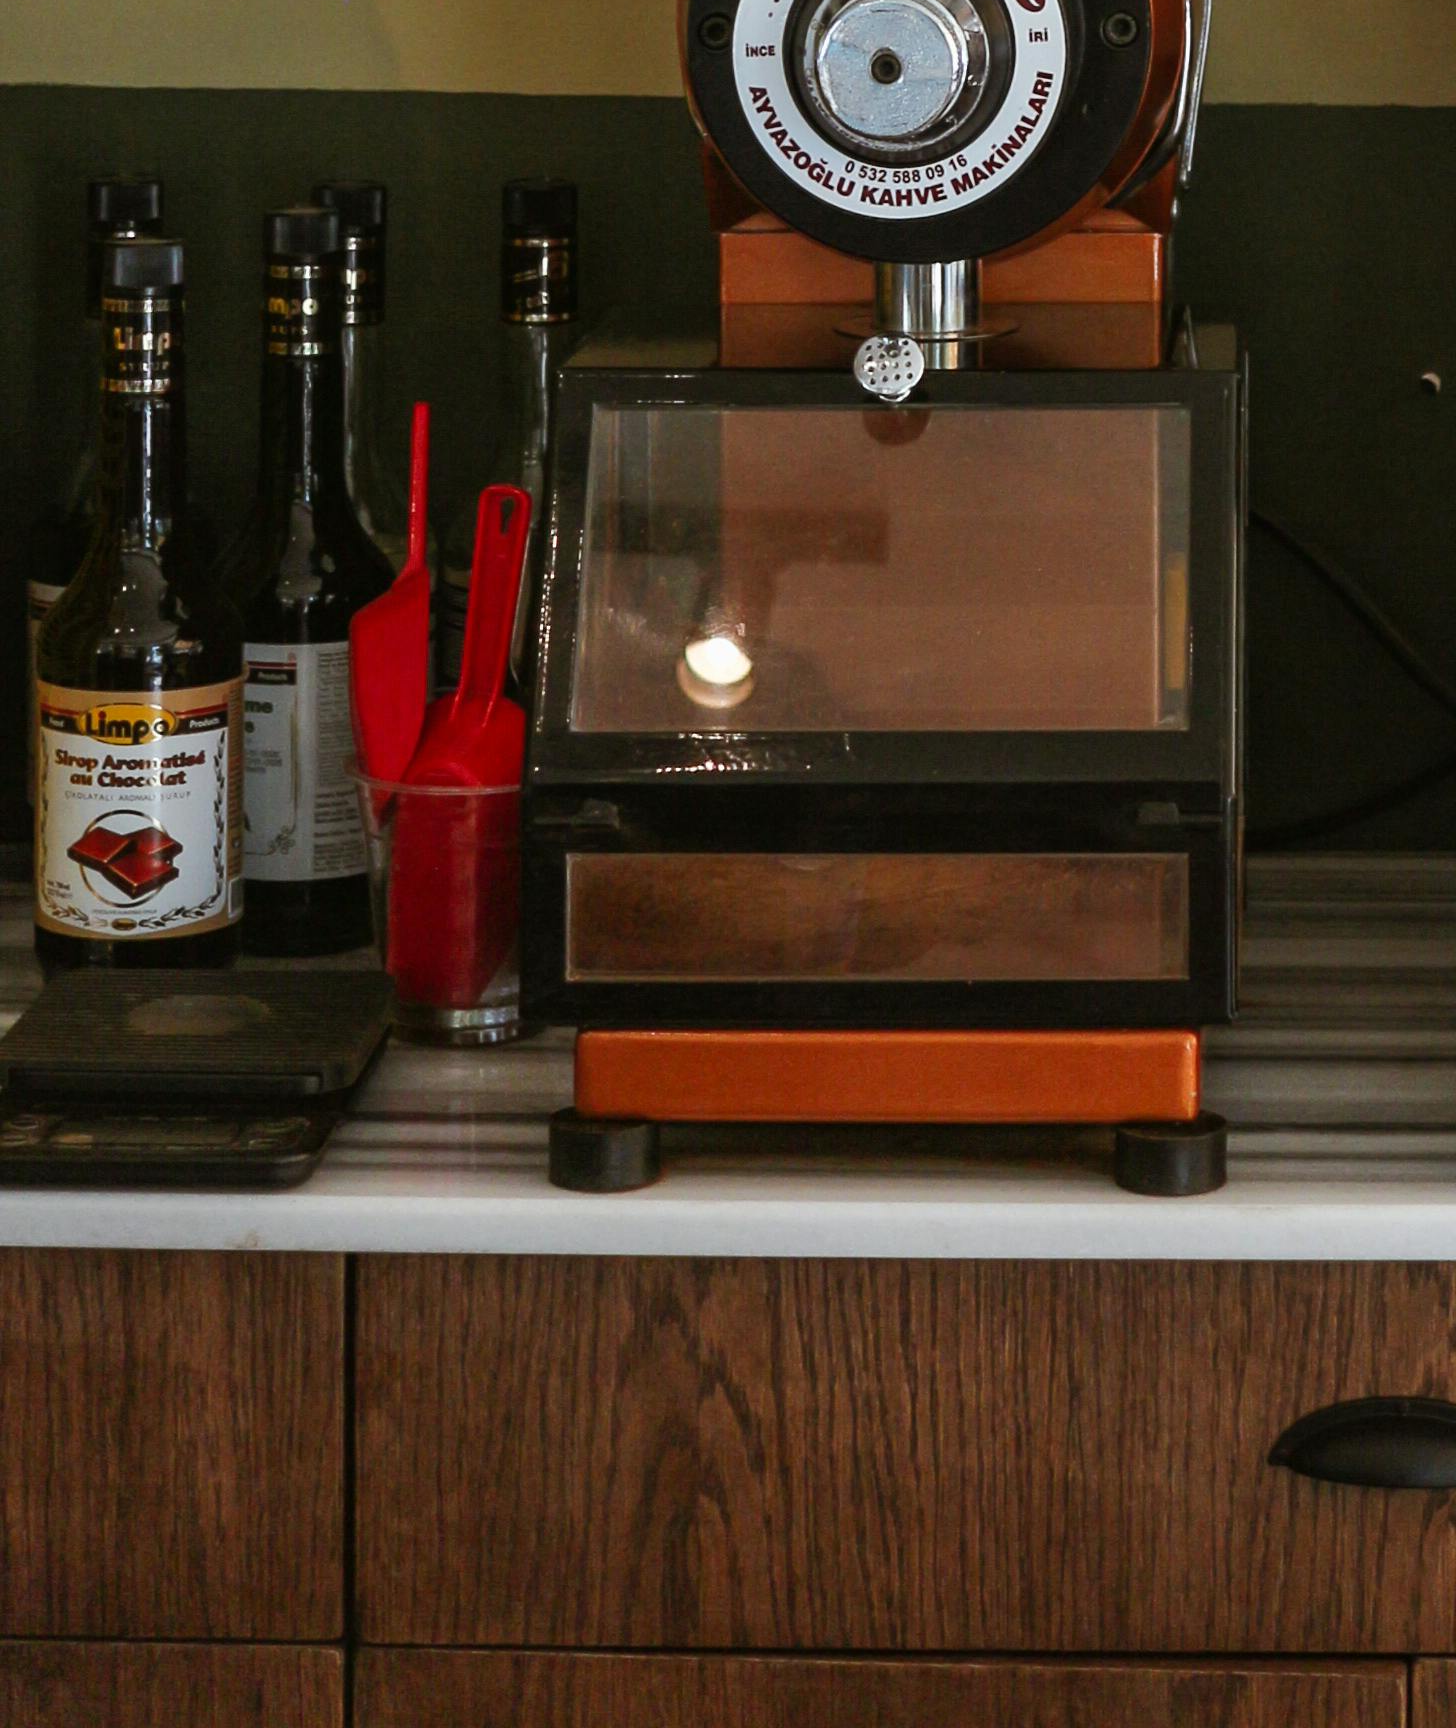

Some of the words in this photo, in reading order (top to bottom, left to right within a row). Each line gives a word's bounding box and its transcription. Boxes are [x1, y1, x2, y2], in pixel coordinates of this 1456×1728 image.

[1028, 27, 1049, 44] İRİ
[745, 43, 776, 58] İNCE
[749, 85, 854, 197] AYVAZOĞLU
[860, 184, 947, 206] KAHVE
[951, 71, 1054, 197] MAKİNALARI
[844, 160, 853, 174] 0
[858, 166, 887, 183] 532
[892, 170, 920, 184] 588
[926, 164, 945, 181] 09
[949, 154, 968, 173] 16
[85, 711, 170, 744] Limpo
[55, 749, 97, 771] Sirop
[102, 750, 205, 770] Aromatisé
[70, 775, 92, 786] au
[97, 771, 187, 787] Chocolat
